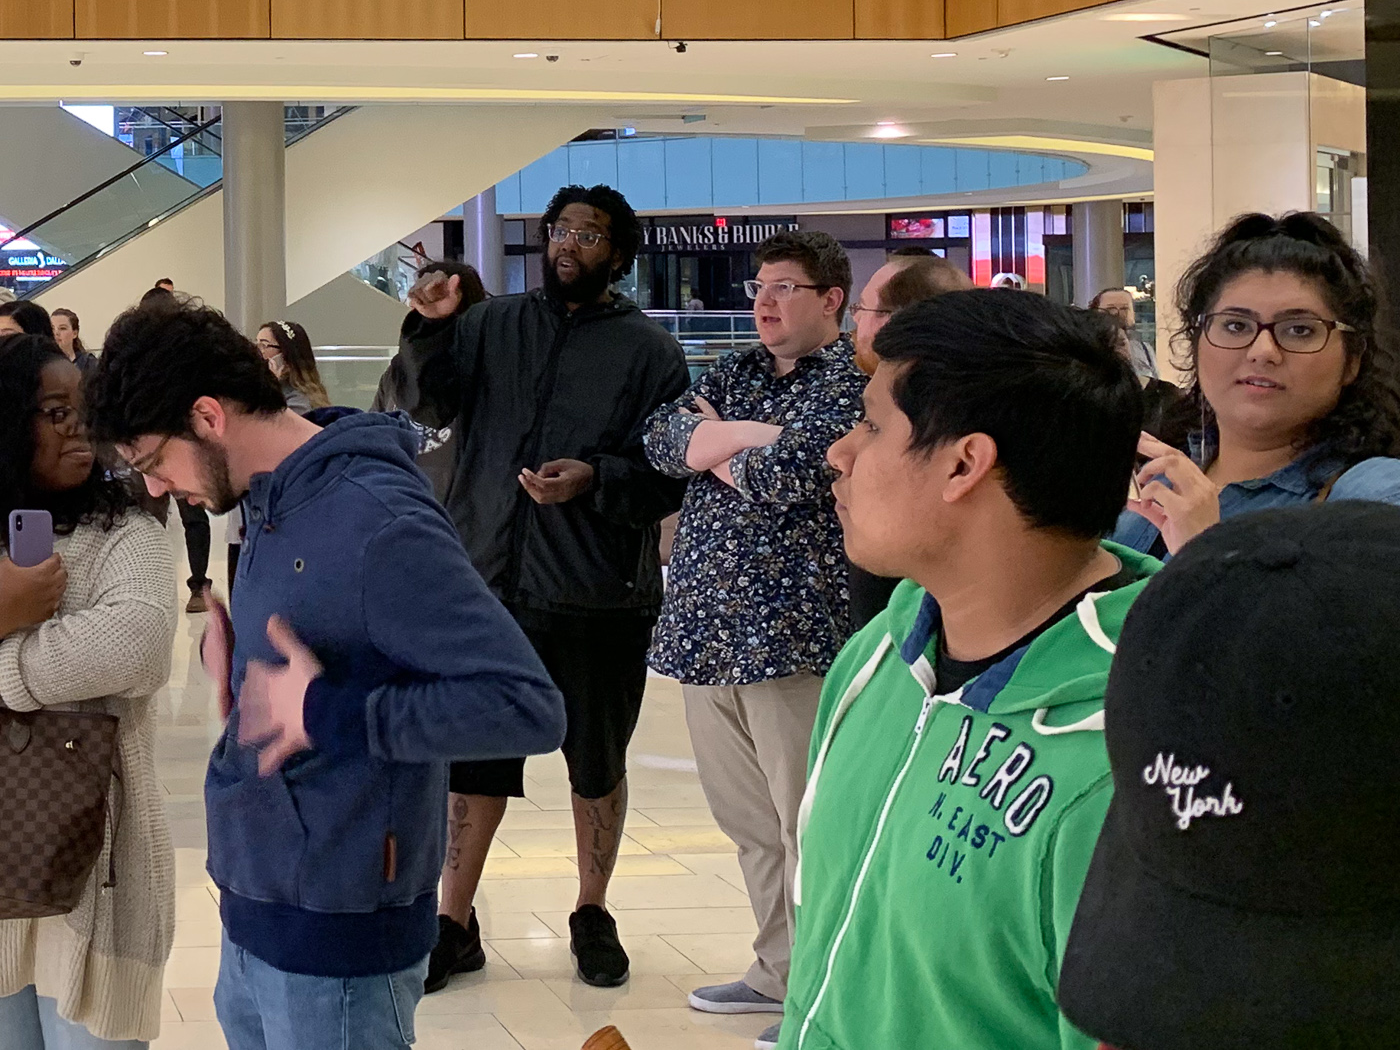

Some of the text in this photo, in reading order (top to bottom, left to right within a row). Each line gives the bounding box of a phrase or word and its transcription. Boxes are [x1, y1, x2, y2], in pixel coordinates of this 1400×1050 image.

[656, 225, 714, 245] BANKS
[718, 225, 729, 243] &
[733, 223, 799, 244] BIDD
[660, 244, 725, 252] JEWELERS
[8, 256, 38, 266] GALLERIA
[937, 715, 1053, 837] AERO
[1143, 751, 1211, 785] New
[1166, 782, 1244, 830] York
[948, 806, 1006, 858] EAST
[926, 835, 966, 884] DIV.
